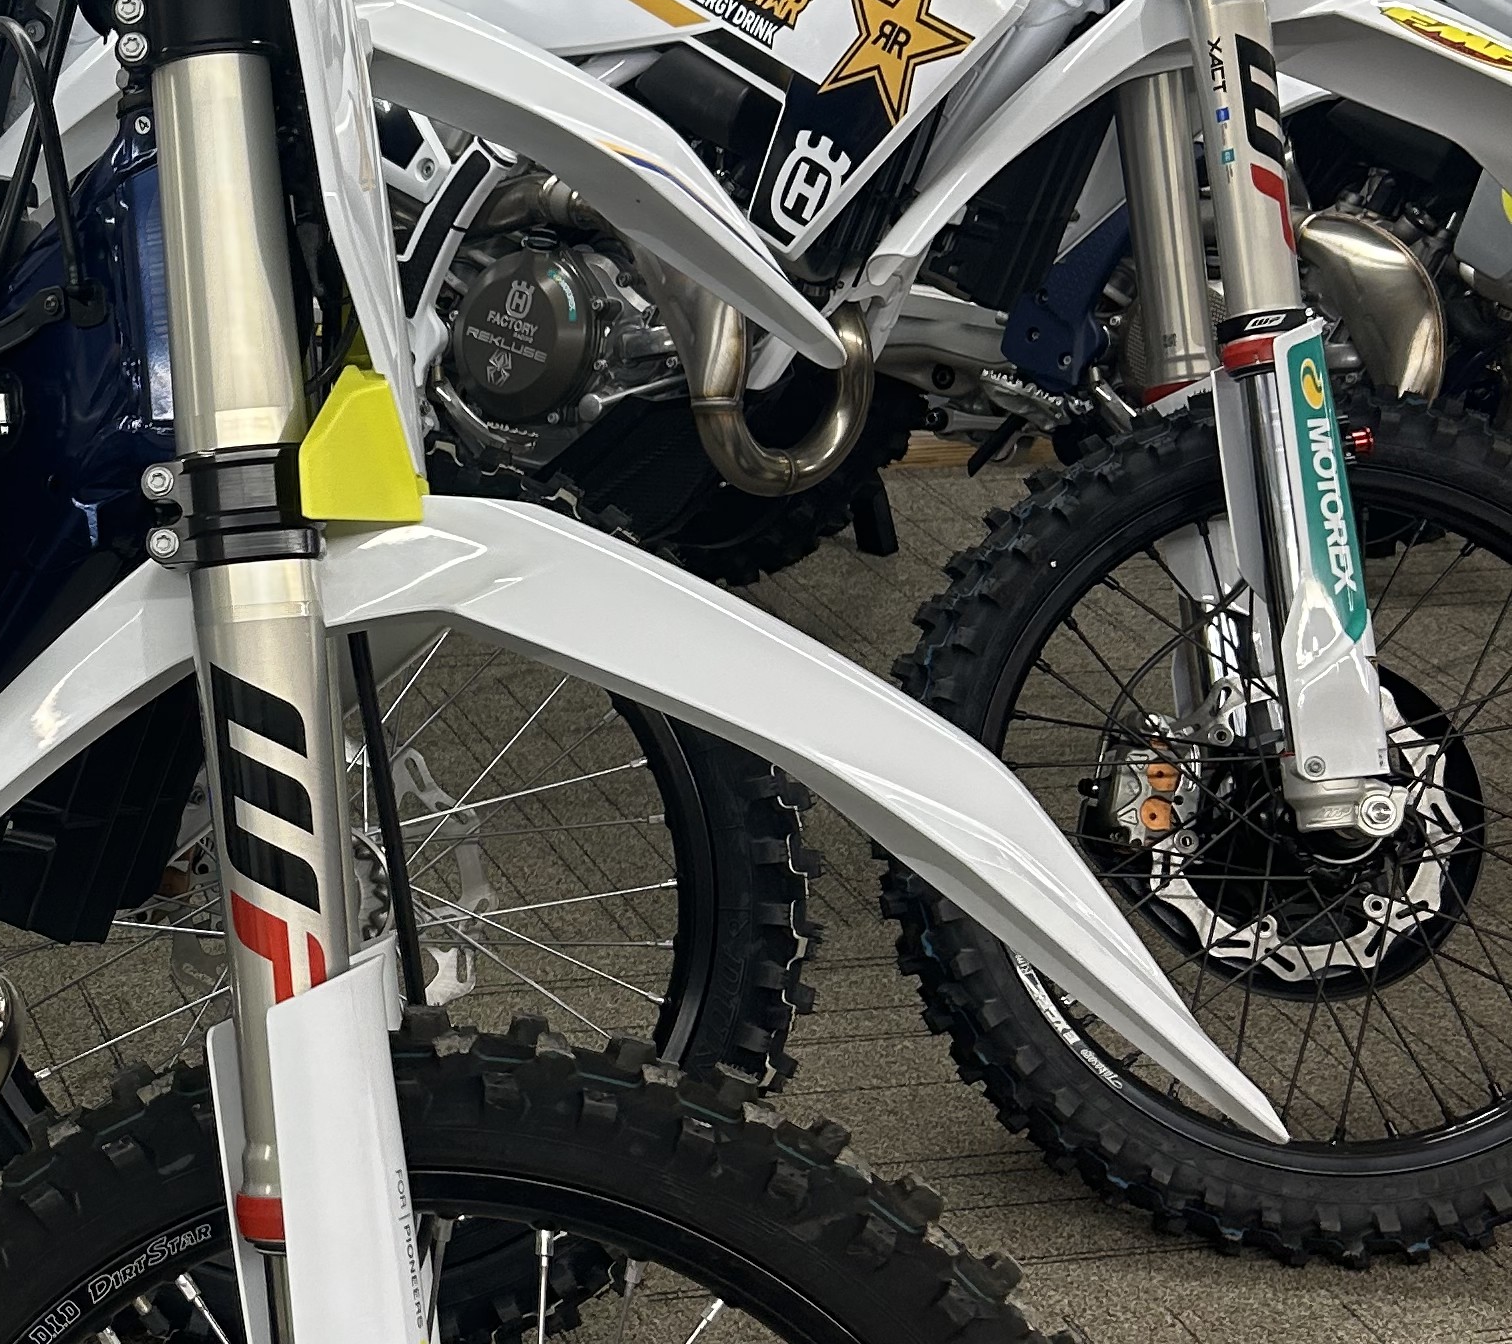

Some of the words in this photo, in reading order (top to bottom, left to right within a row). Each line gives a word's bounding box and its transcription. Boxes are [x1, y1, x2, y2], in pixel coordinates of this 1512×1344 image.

[734, 2, 779, 47] DRINK
[1206, 36, 1228, 93] XACT
[466, 325, 548, 364] REKLUSE
[486, 309, 539, 337] FACTORY
[1306, 417, 1358, 595] MOTOREX
[394, 1168, 407, 1210] FOR
[403, 1223, 425, 1330] PIONEERS
